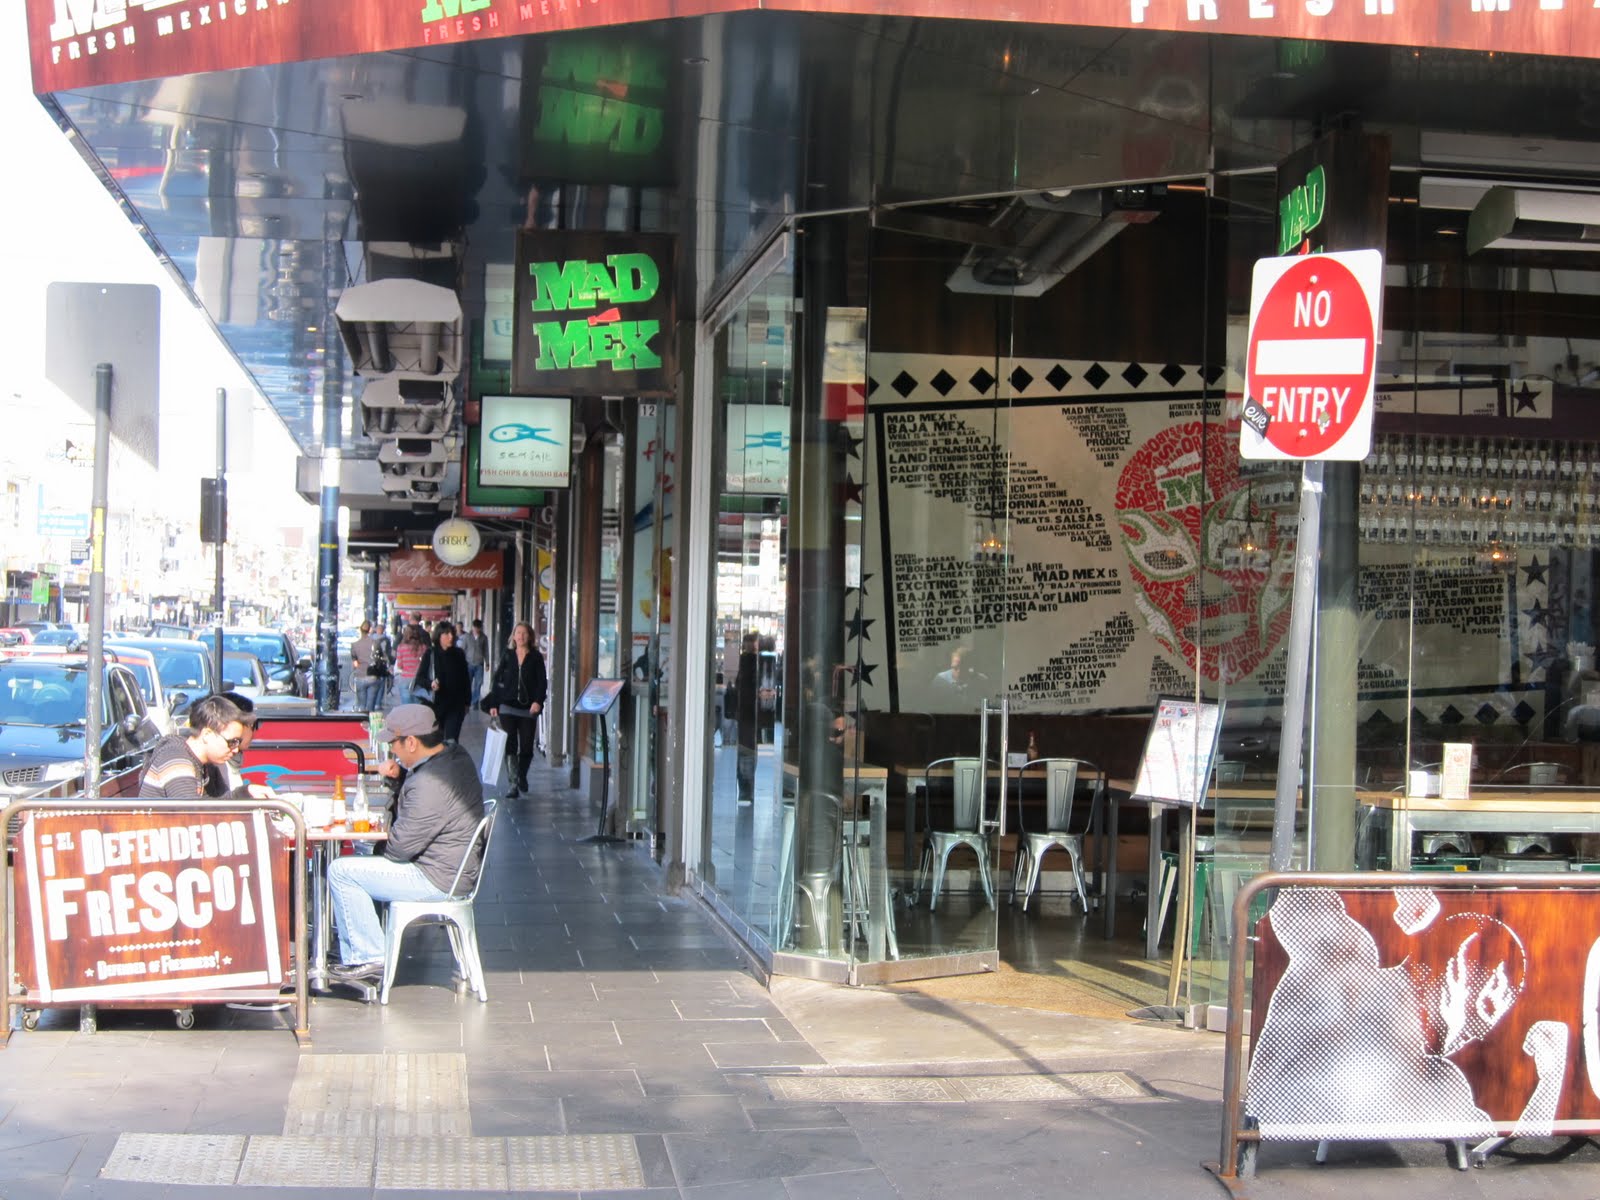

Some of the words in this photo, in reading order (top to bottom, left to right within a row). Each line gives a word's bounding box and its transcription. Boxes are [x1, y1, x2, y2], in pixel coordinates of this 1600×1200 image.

[424, 11, 499, 43] FRESH
[520, 0, 600, 21] MEXI
[52, 26, 136, 64] FRESH
[529, 253, 660, 311] MAD
[1293, 290, 1332, 327] NO
[533, 319, 662, 371] MEX
[642, 404, 655, 417] 12
[1061, 407, 1084, 416] MAD
[1085, 406, 1104, 414] MEX
[1262, 386, 1351, 424] ENTRY
[887, 414, 915, 424] MAD
[919, 413, 946, 423] MEX
[887, 422, 928, 434] BAJA
[1079, 424, 1106, 432] ORDER
[889, 453, 928, 465] LAND
[890, 463, 956, 474] CALIFORNIA
[890, 473, 935, 484] PACIFIC
[1058, 498, 1084, 508] MAD
[1060, 506, 1092, 515] ROAST
[896, 572, 931, 582] MEATS
[1026, 562, 1043, 572] ARE
[896, 579, 958, 592] EXCITING
[1032, 569, 1069, 582] MAD
[1072, 567, 1106, 580] MEX
[1108, 568, 1119, 578] IS
[897, 590, 936, 603] BAJA
[1058, 590, 1088, 604] LAND
[898, 608, 934, 619] SOUTH
[937, 608, 949, 617] OF
[952, 601, 1037, 616] CALIFORNIA
[898, 617, 943, 628] MEXICO
[973, 611, 1028, 625] PACIFIC
[1105, 619, 1134, 629] MEANS
[1049, 655, 1098, 666] METHODS
[1008, 683, 1019, 691] LA
